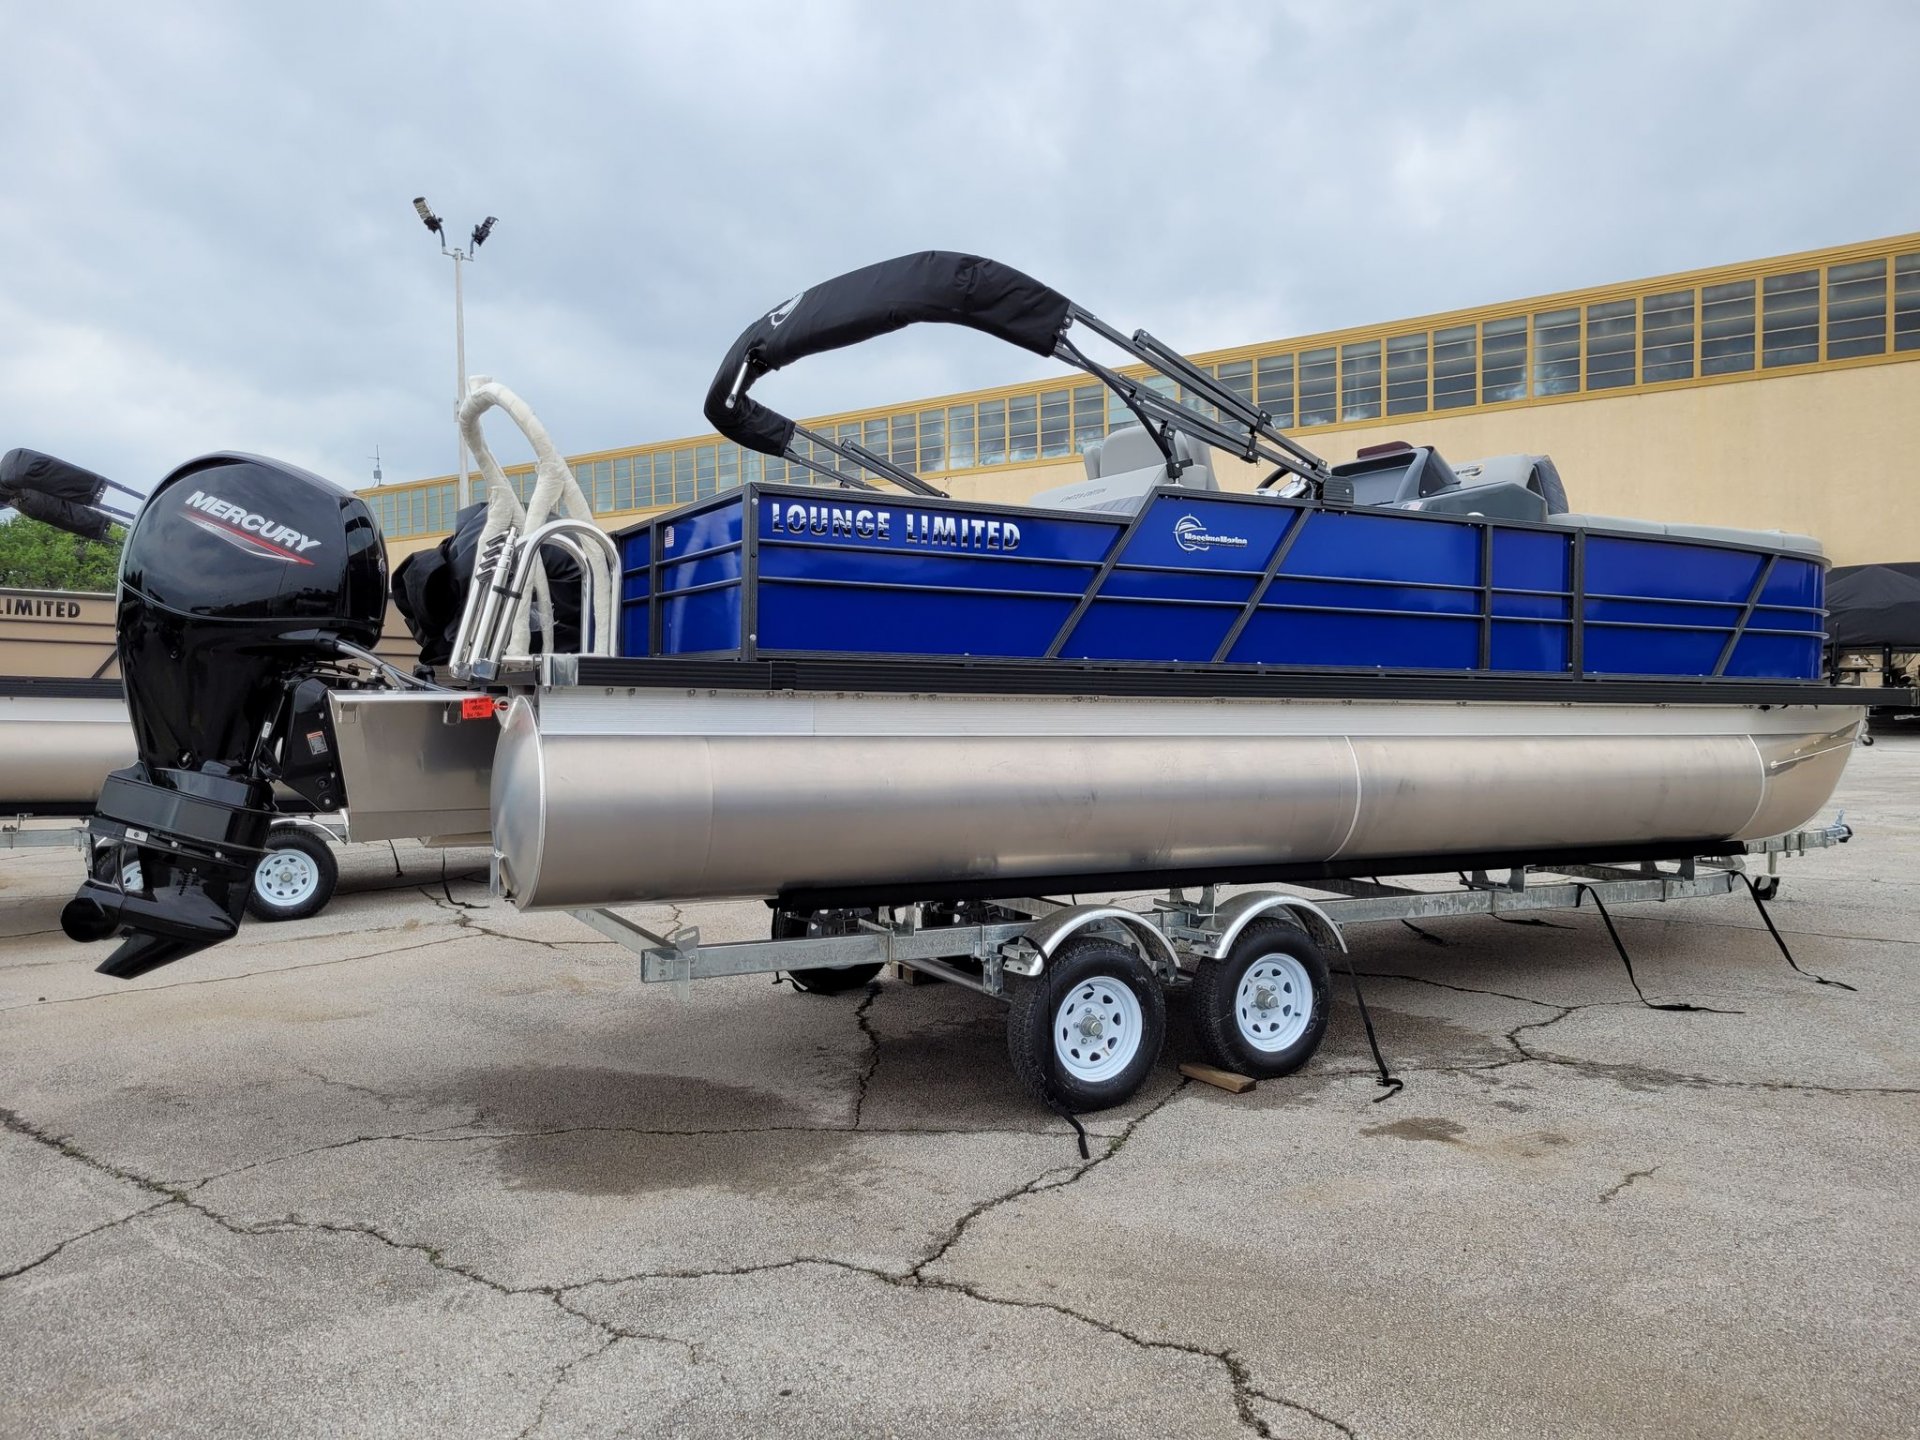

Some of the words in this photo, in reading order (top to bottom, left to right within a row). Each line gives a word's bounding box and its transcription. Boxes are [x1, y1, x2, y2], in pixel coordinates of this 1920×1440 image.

[185, 490, 321, 552] MERCURY
[771, 503, 890, 540] LOUNGE
[906, 514, 1021, 550] LIMITED
